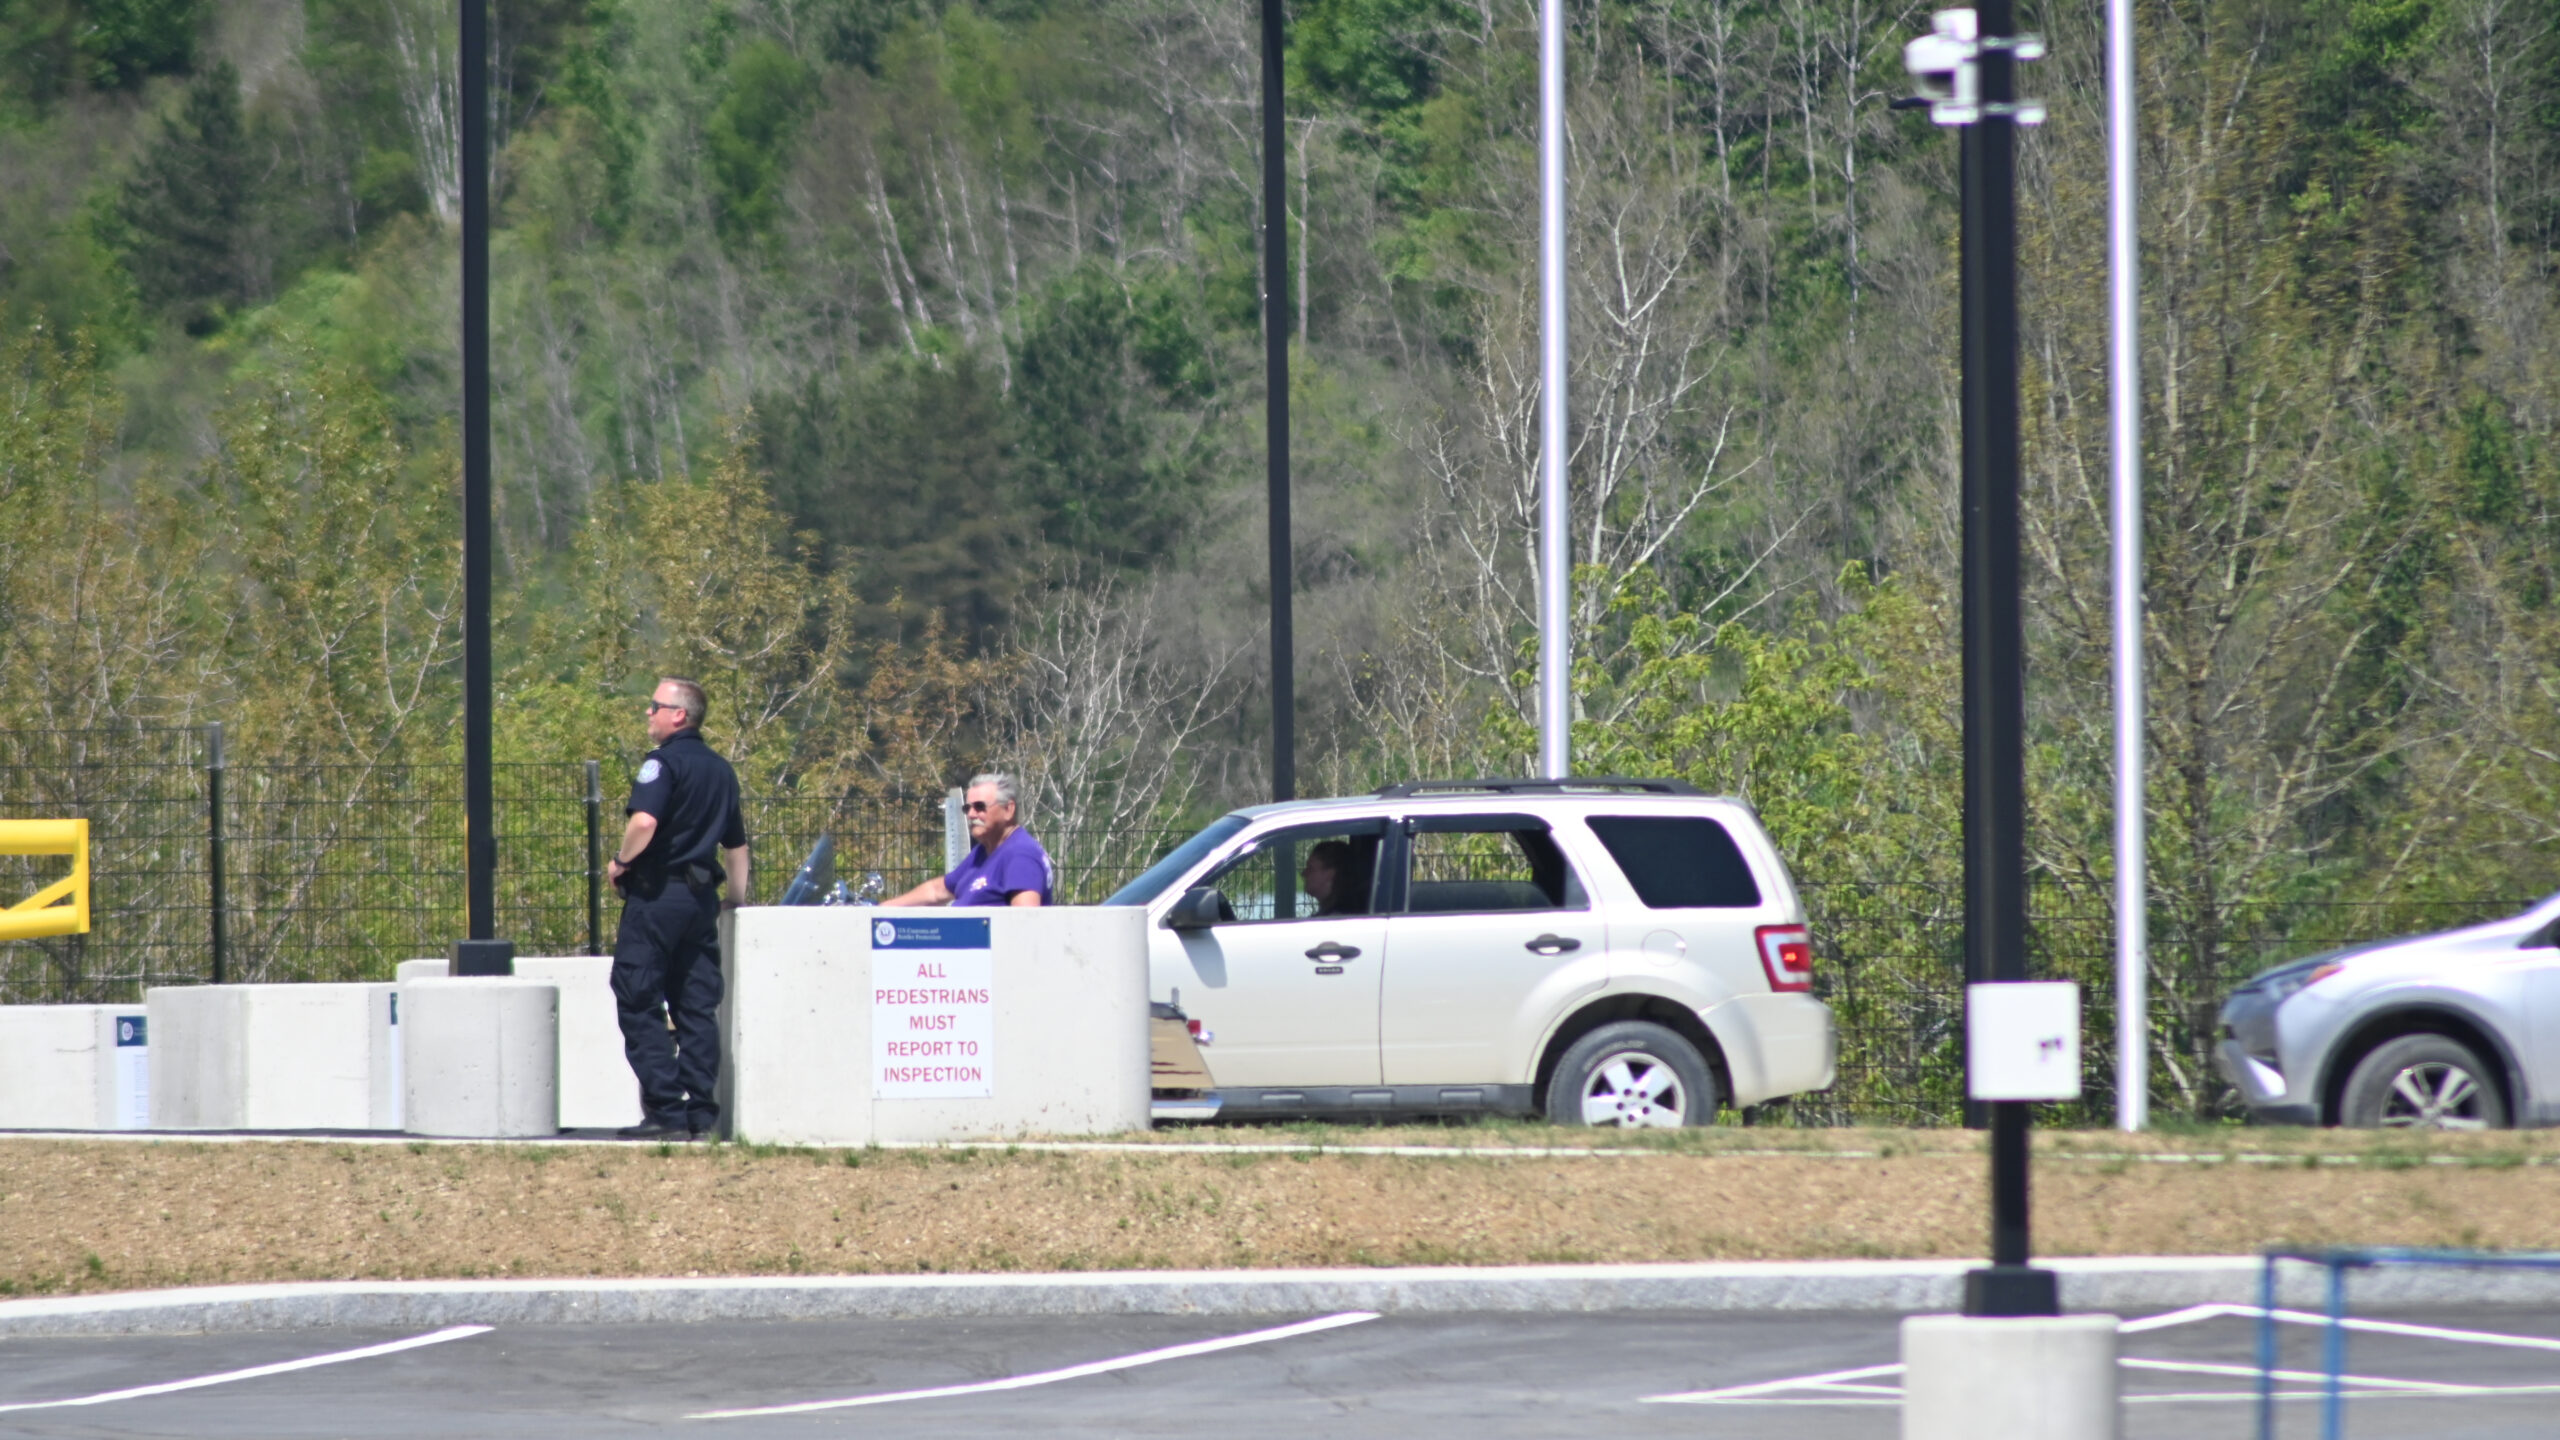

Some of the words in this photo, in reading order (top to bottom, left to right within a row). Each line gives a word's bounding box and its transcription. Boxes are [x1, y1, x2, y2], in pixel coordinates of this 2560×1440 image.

[917, 963, 946, 978] ALL
[876, 989, 990, 1004] PEDESTRIANS
[909, 1015, 956, 1030] MUST
[887, 1041, 953, 1056] REPORT
[958, 1041, 978, 1056] TO
[884, 1067, 982, 1082] INSPECTION
